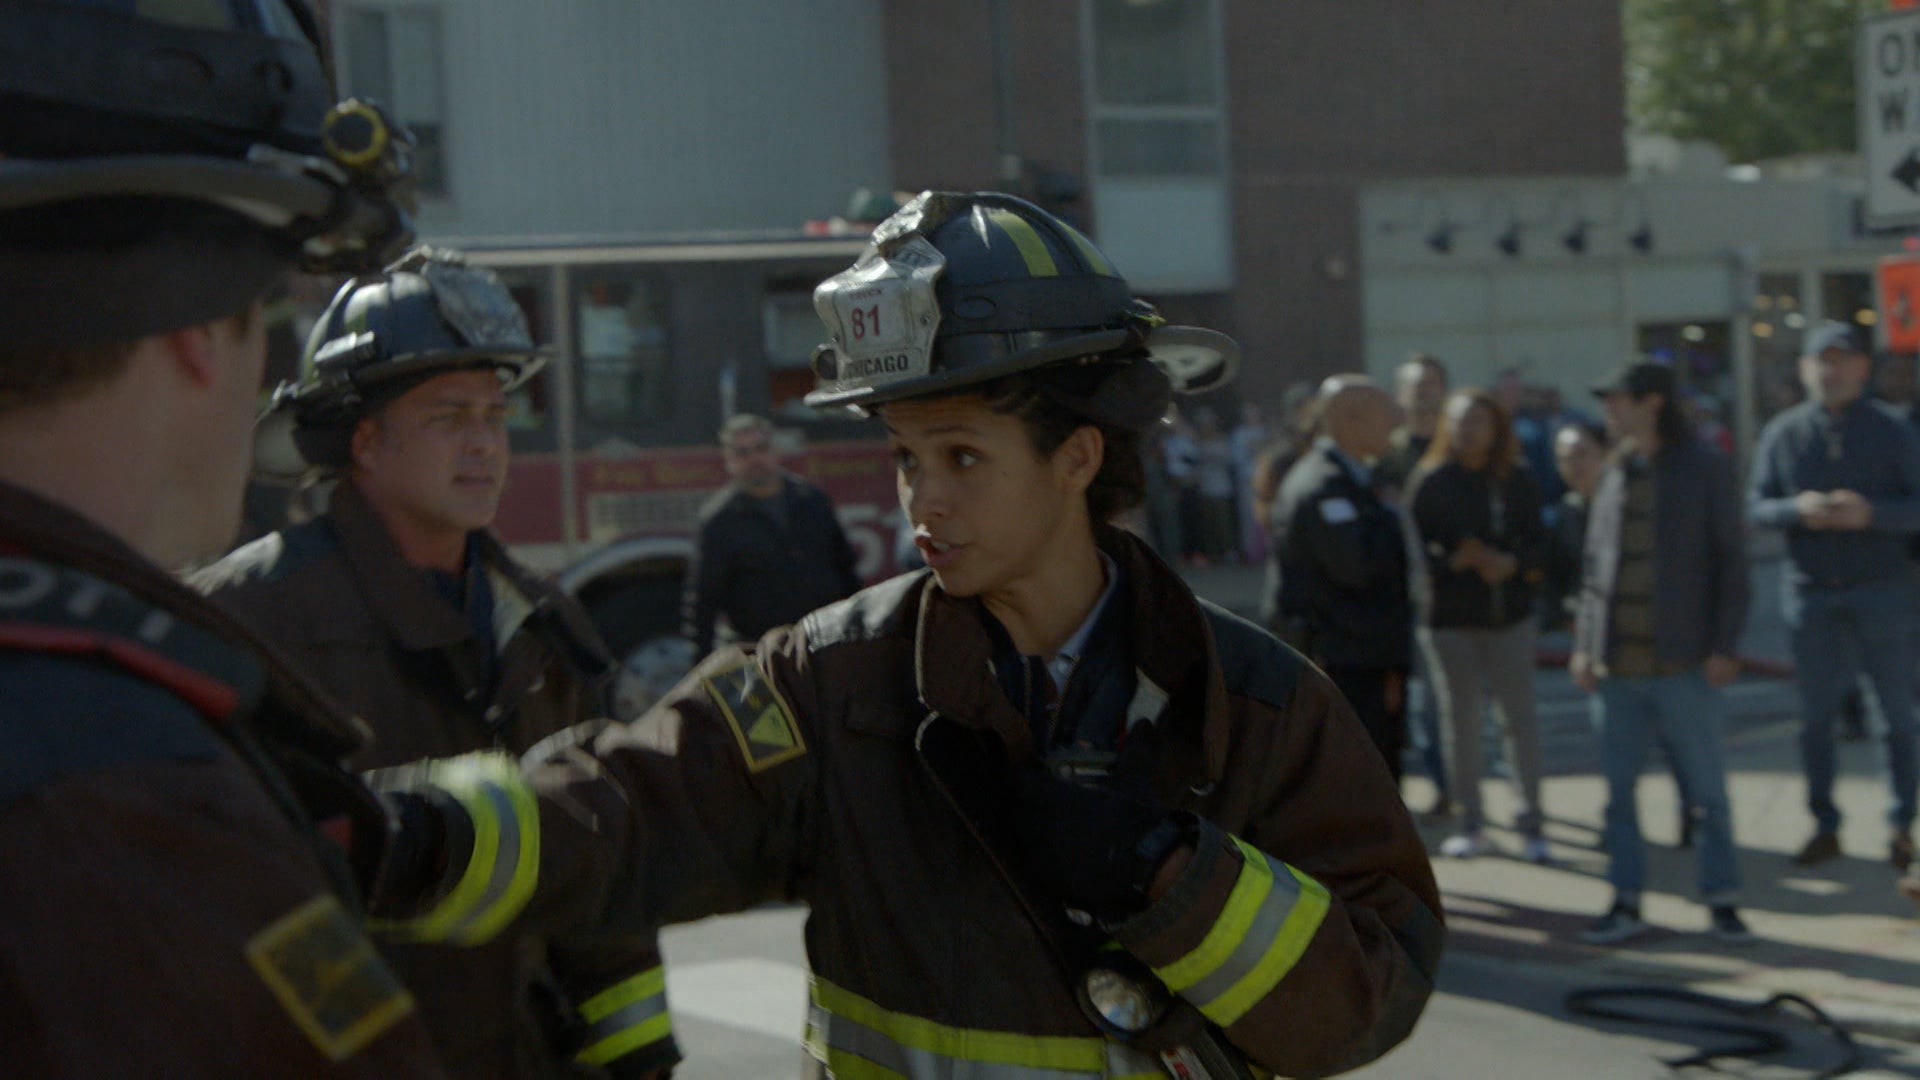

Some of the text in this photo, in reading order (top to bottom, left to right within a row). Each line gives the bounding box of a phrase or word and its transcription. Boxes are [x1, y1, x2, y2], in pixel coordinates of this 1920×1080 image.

[1877, 31, 1920, 76] O
[1878, 88, 1914, 133] W
[851, 304, 880, 339] 81
